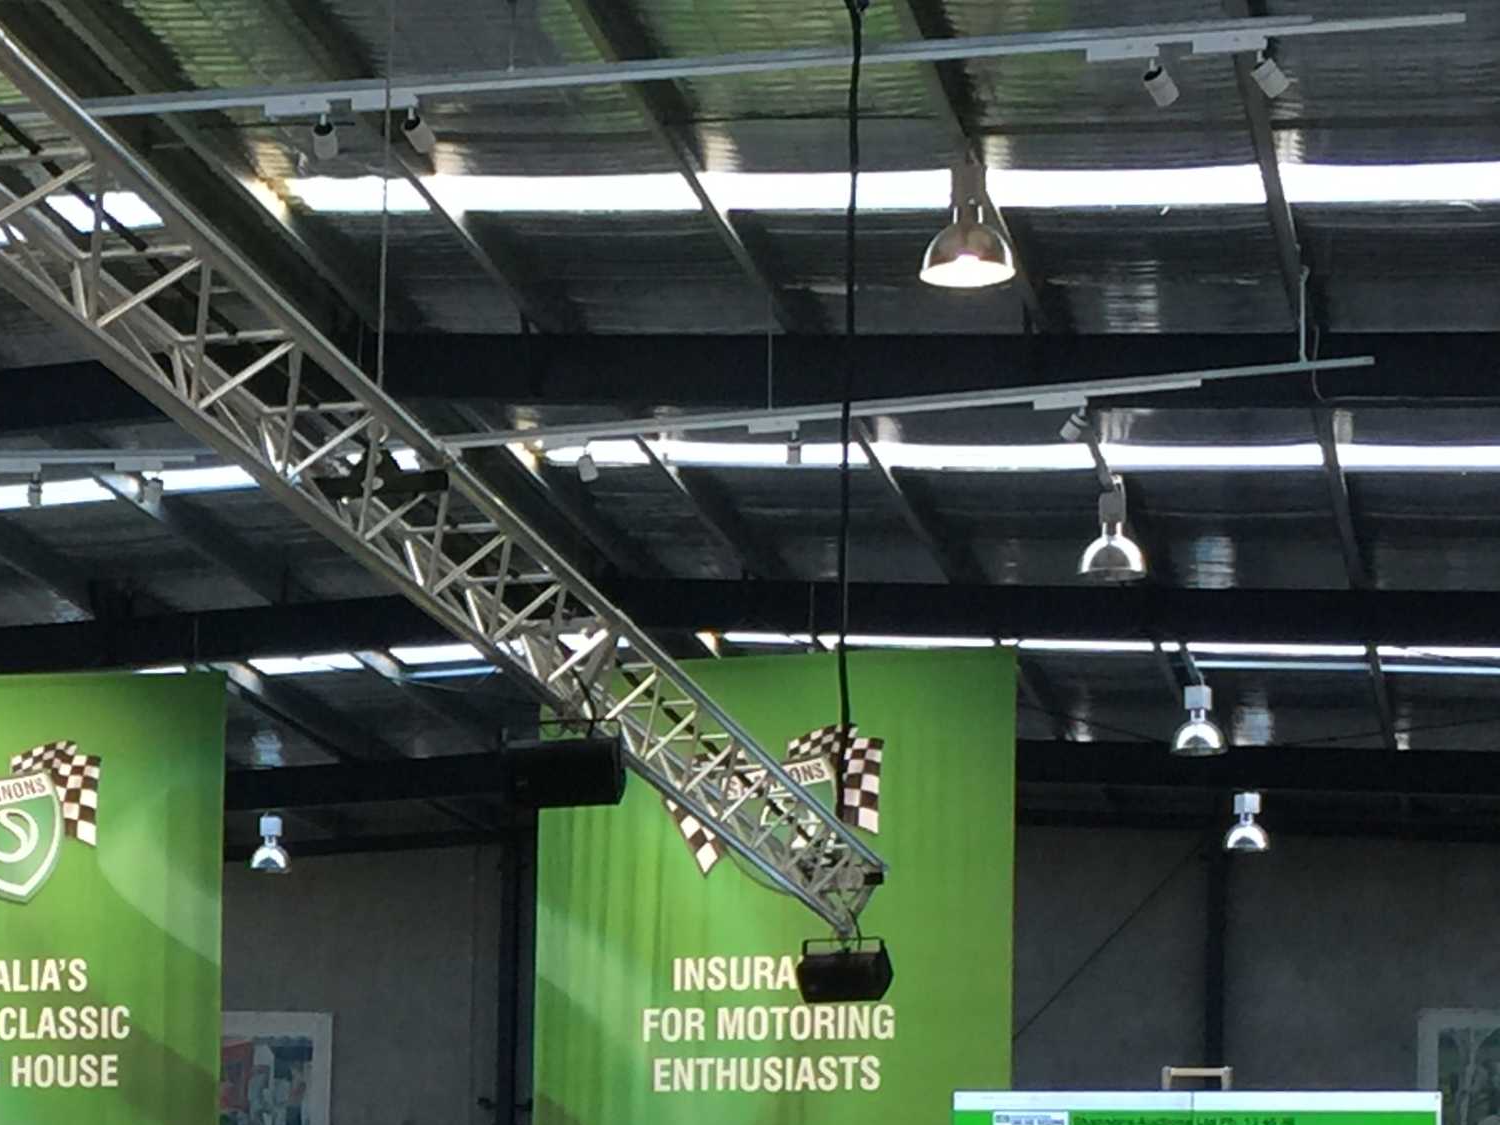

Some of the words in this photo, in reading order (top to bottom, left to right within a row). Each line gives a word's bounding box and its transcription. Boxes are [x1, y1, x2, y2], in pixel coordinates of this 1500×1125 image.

[673, 956, 802, 992] INSURA
[642, 1008, 705, 1042] FOR
[717, 1005, 895, 1041] MOTORING
[10, 1054, 119, 1088] HOUSE
[653, 1055, 881, 1093] ENTHUSIASTS
